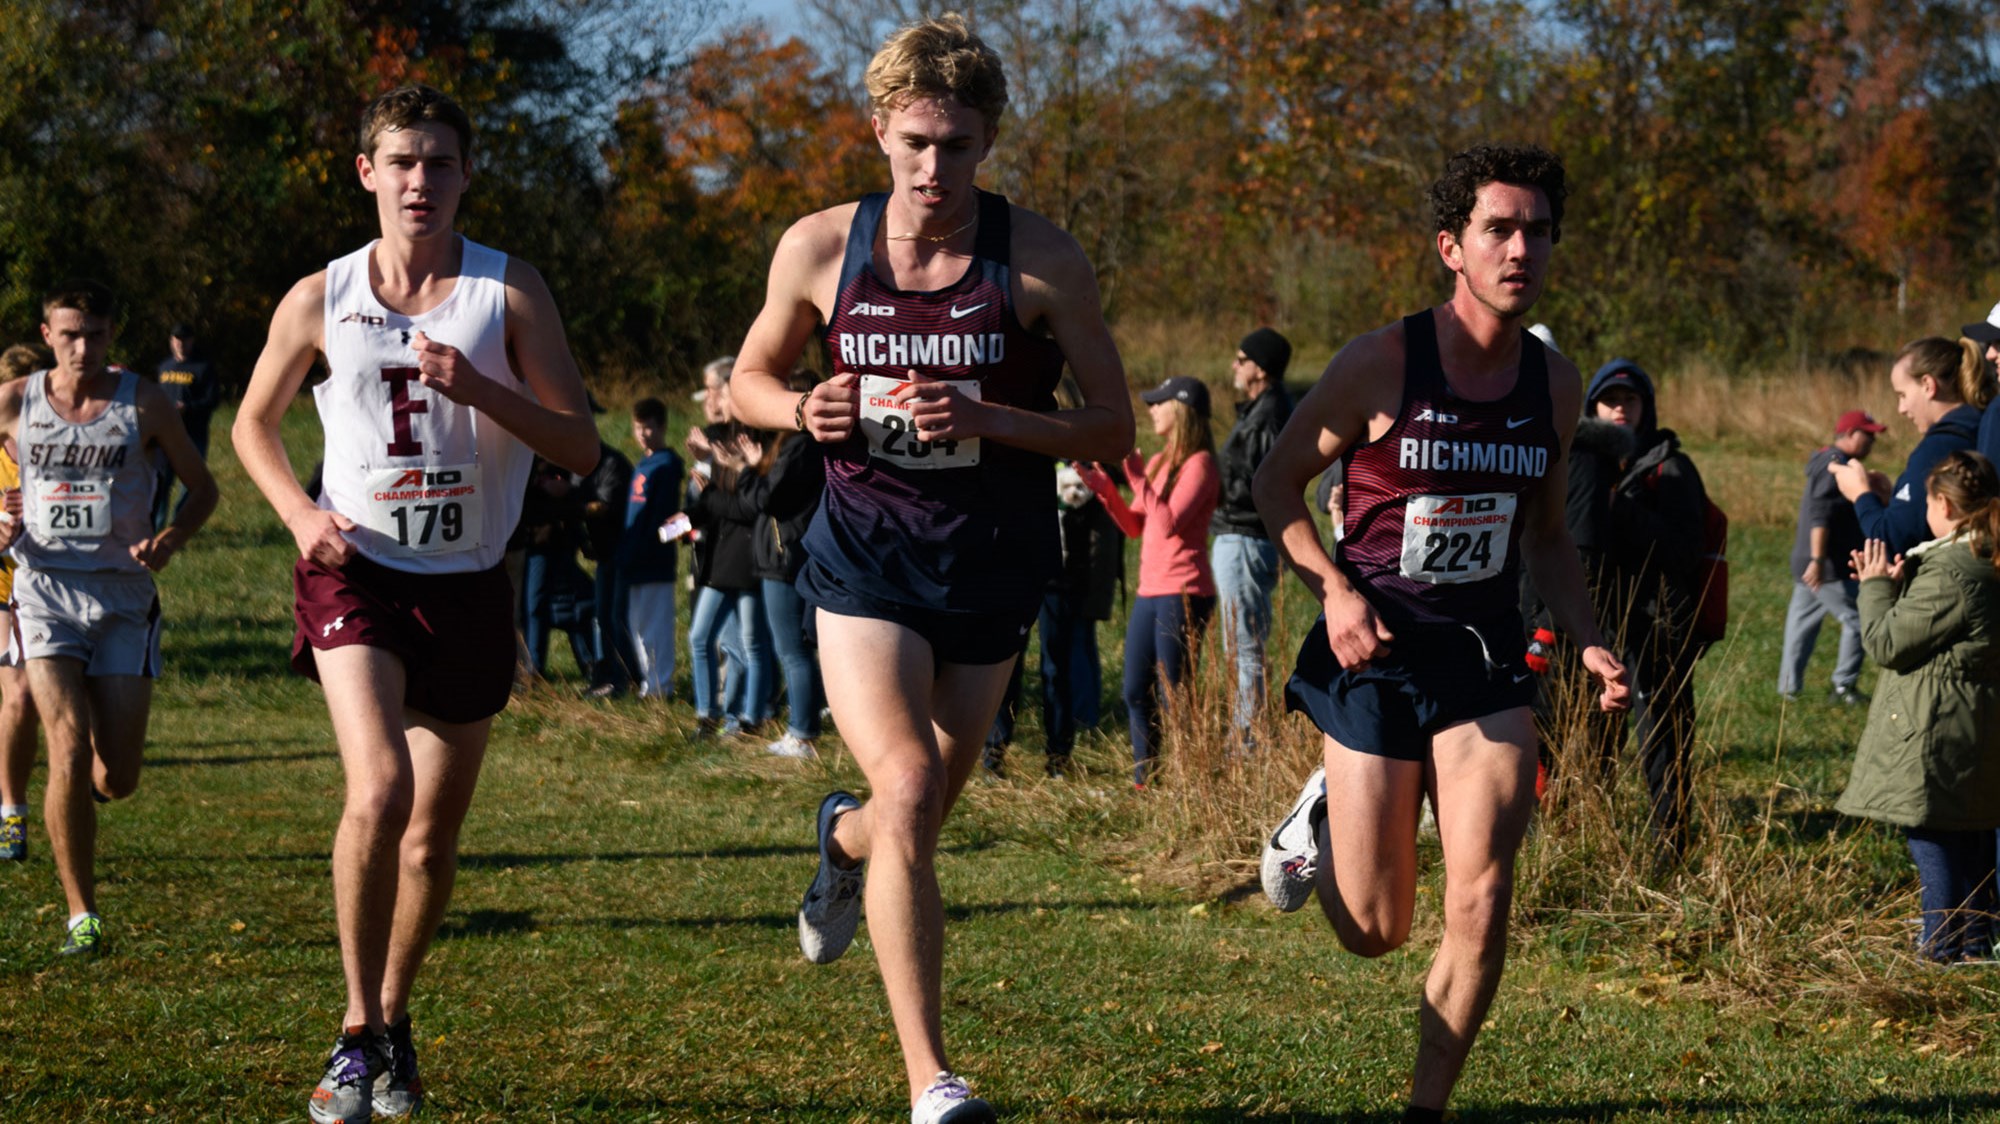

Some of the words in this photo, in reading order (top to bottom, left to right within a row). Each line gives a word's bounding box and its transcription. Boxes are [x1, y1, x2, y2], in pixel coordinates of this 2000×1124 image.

[848, 302, 895, 317] A10
[839, 332, 1005, 366] RICHMOND
[381, 367, 429, 457] F
[1414, 409, 1458, 424] A10
[63, 444, 127, 468] BONA
[1399, 437, 1548, 478] RICHMOND
[53, 482, 95, 493] A10
[391, 468, 462, 488] A10
[374, 485, 475, 501] CHAMPIONSHIPS
[50, 504, 94, 529] 251
[1432, 497, 1497, 515] A10
[391, 502, 463, 546] 179
[1413, 514, 1508, 527] CHAMPIONSHIPS
[1421, 530, 1493, 573] 224
